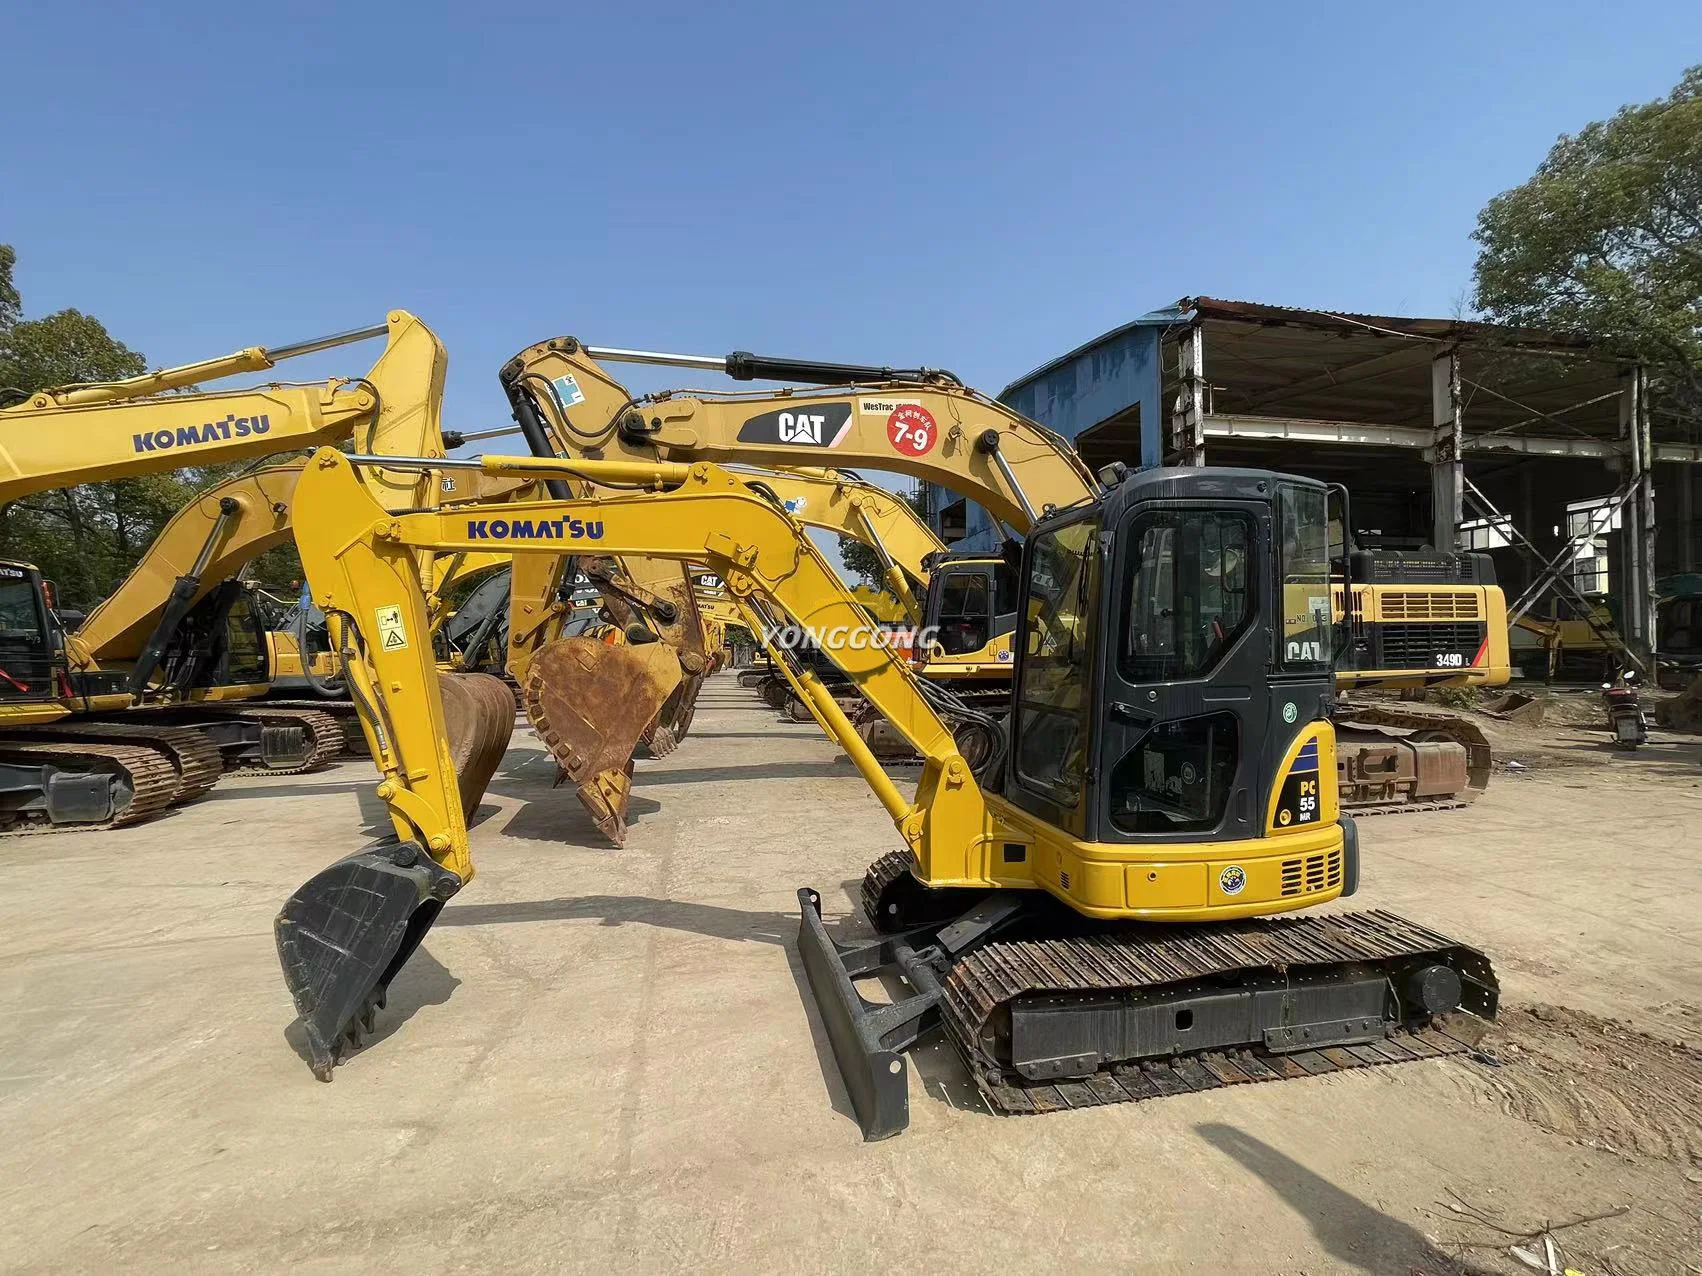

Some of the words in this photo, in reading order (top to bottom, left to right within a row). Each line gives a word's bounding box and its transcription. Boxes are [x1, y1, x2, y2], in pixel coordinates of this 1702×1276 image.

[863, 402, 894, 411] WesTrac
[132, 414, 270, 453] KOMATSU
[778, 412, 825, 444] CAT
[894, 420, 929, 451] 7-9
[467, 515, 604, 540] KOMATSU
[701, 574, 718, 587] CAT
[1287, 641, 1320, 661] CAT
[1436, 653, 1462, 667] 349D
[1300, 780, 1316, 796] PC
[1299, 796, 1316, 812] 55
[1299, 812, 1311, 822] MR
